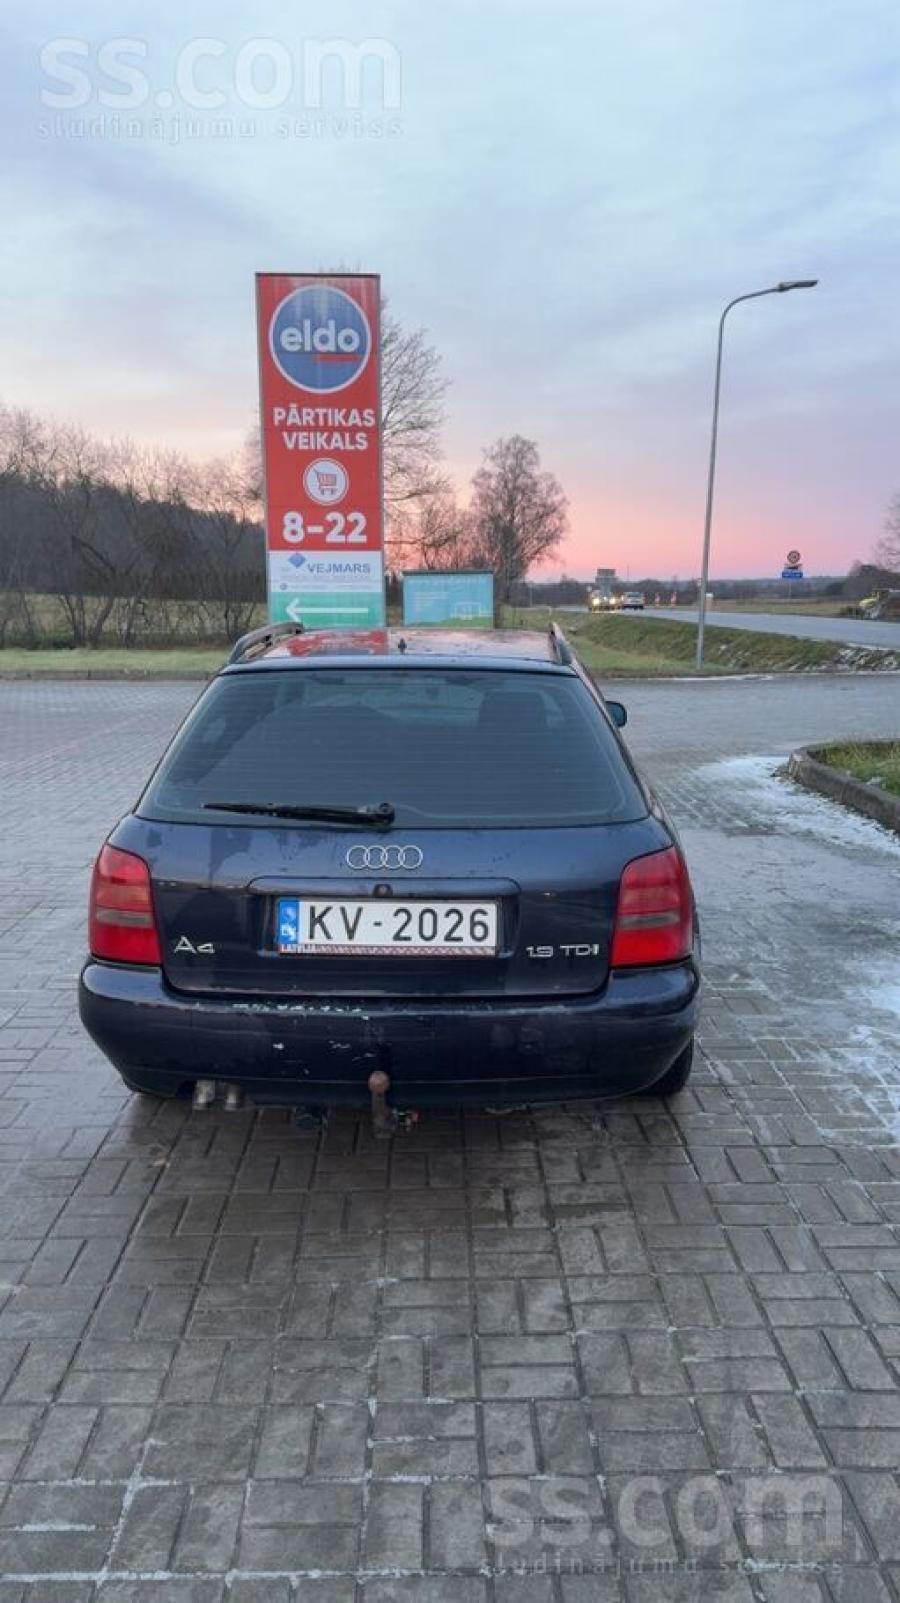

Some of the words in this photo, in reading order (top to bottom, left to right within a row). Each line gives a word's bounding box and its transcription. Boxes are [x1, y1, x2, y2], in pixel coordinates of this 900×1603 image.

[279, 318, 361, 354] eldo
[273, 404, 376, 427] PĀRTIKAS
[283, 431, 369, 451] VEIKALS
[307, 563, 371, 574] VEJMARS
[174, 935, 215, 954] A4
[559, 943, 600, 957] TDI
